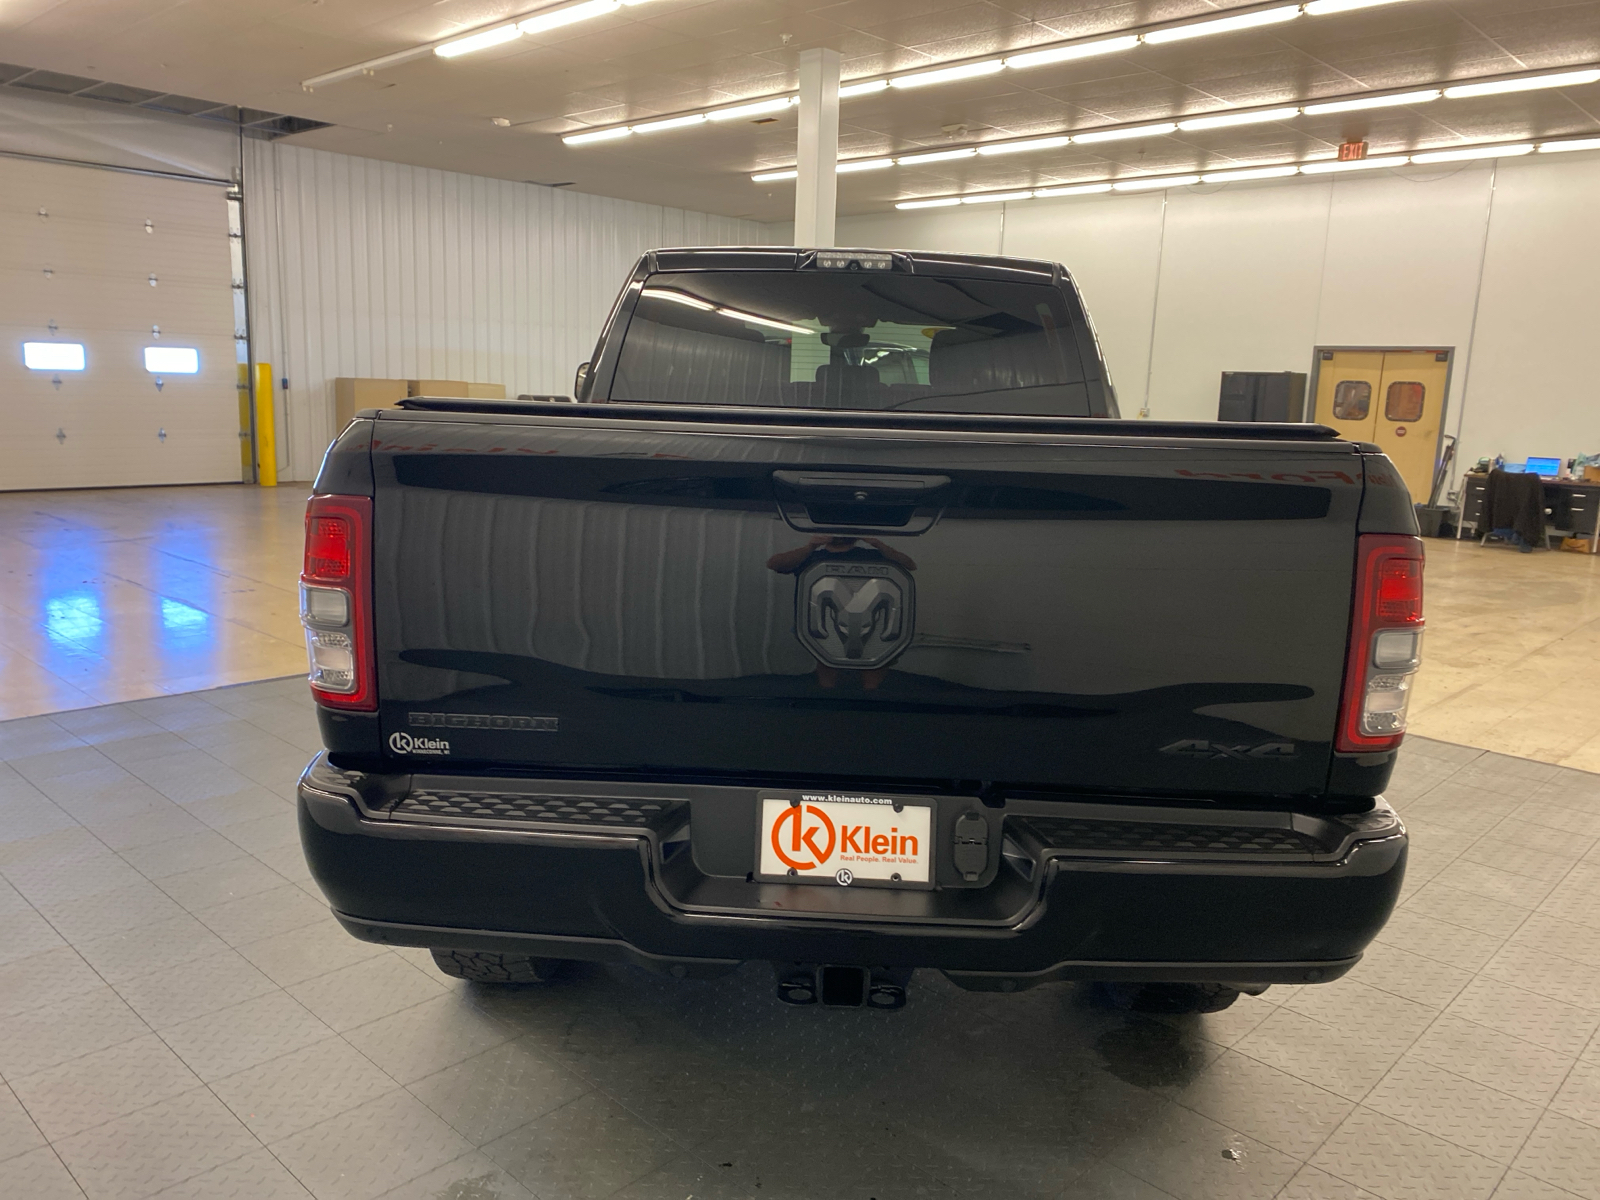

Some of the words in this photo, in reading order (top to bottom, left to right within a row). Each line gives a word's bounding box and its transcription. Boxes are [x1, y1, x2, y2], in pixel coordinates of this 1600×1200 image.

[1342, 142, 1364, 160] EXIT
[825, 564, 889, 576] RAM
[414, 737, 450, 750] Klein
[801, 794, 893, 805] www.kleinauto.com
[840, 825, 918, 856] Klein
[856, 855, 880, 863] People.
